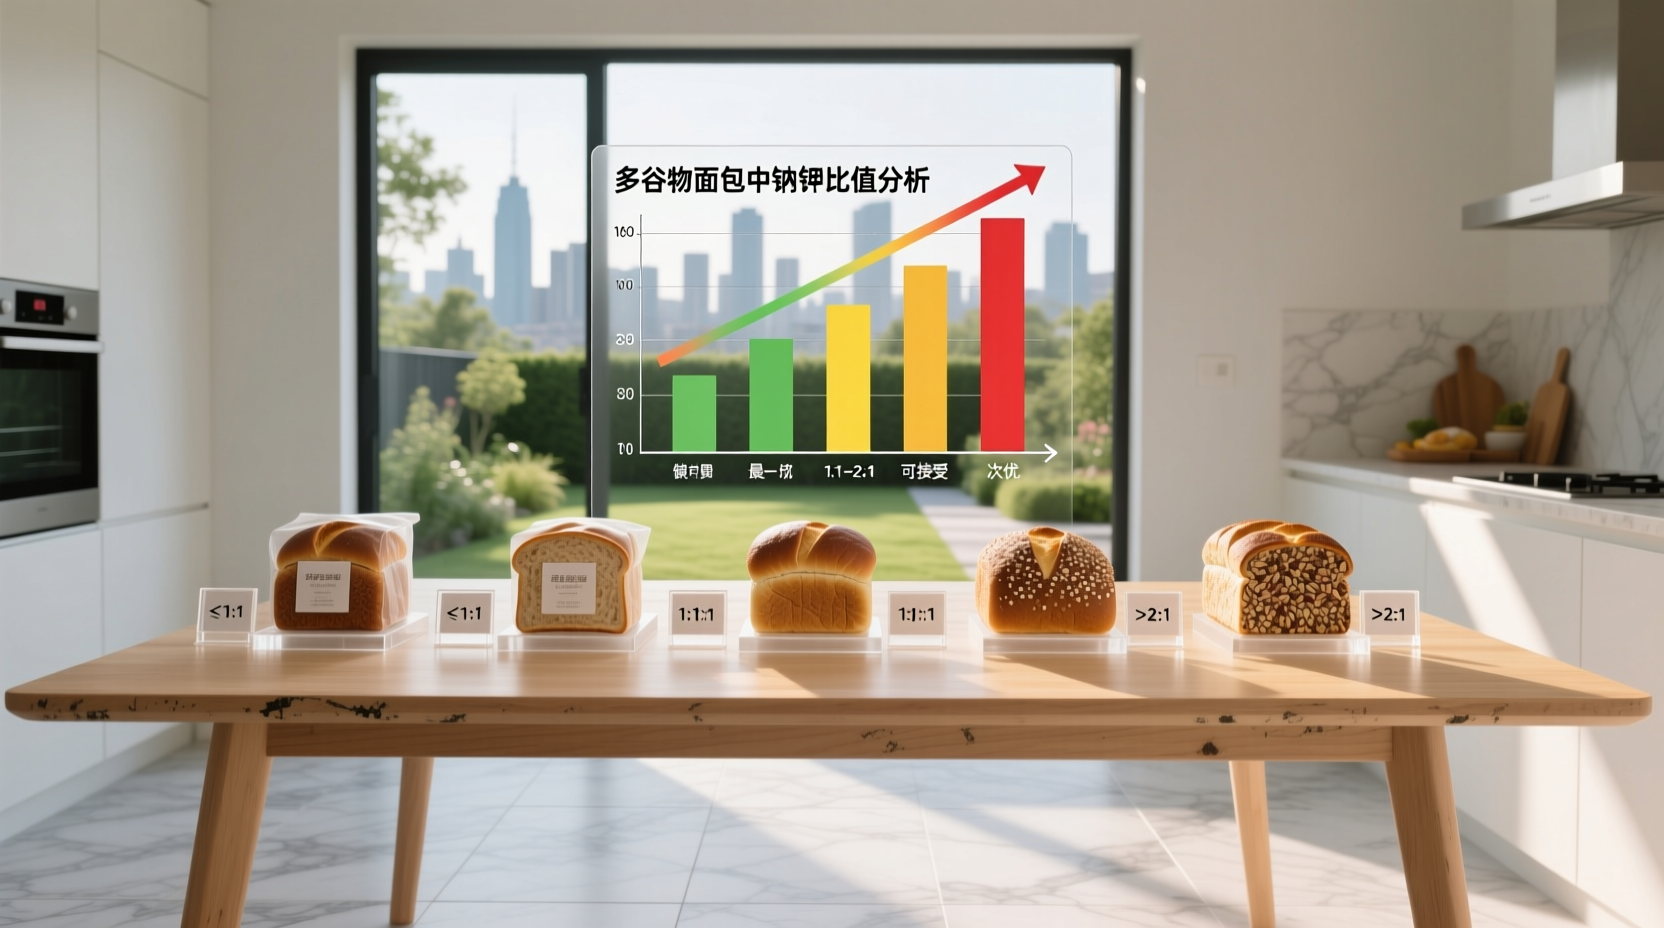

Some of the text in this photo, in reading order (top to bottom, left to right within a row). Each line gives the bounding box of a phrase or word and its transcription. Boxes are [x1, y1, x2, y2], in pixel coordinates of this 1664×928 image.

[615, 165, 930, 194] 多谷物面包中钠钾比值分析
[900, 461, 949, 480] 可接受
[987, 462, 1021, 480] 次优
[1135, 607, 1170, 622] >2:1
[1371, 607, 1406, 622] >2:1
